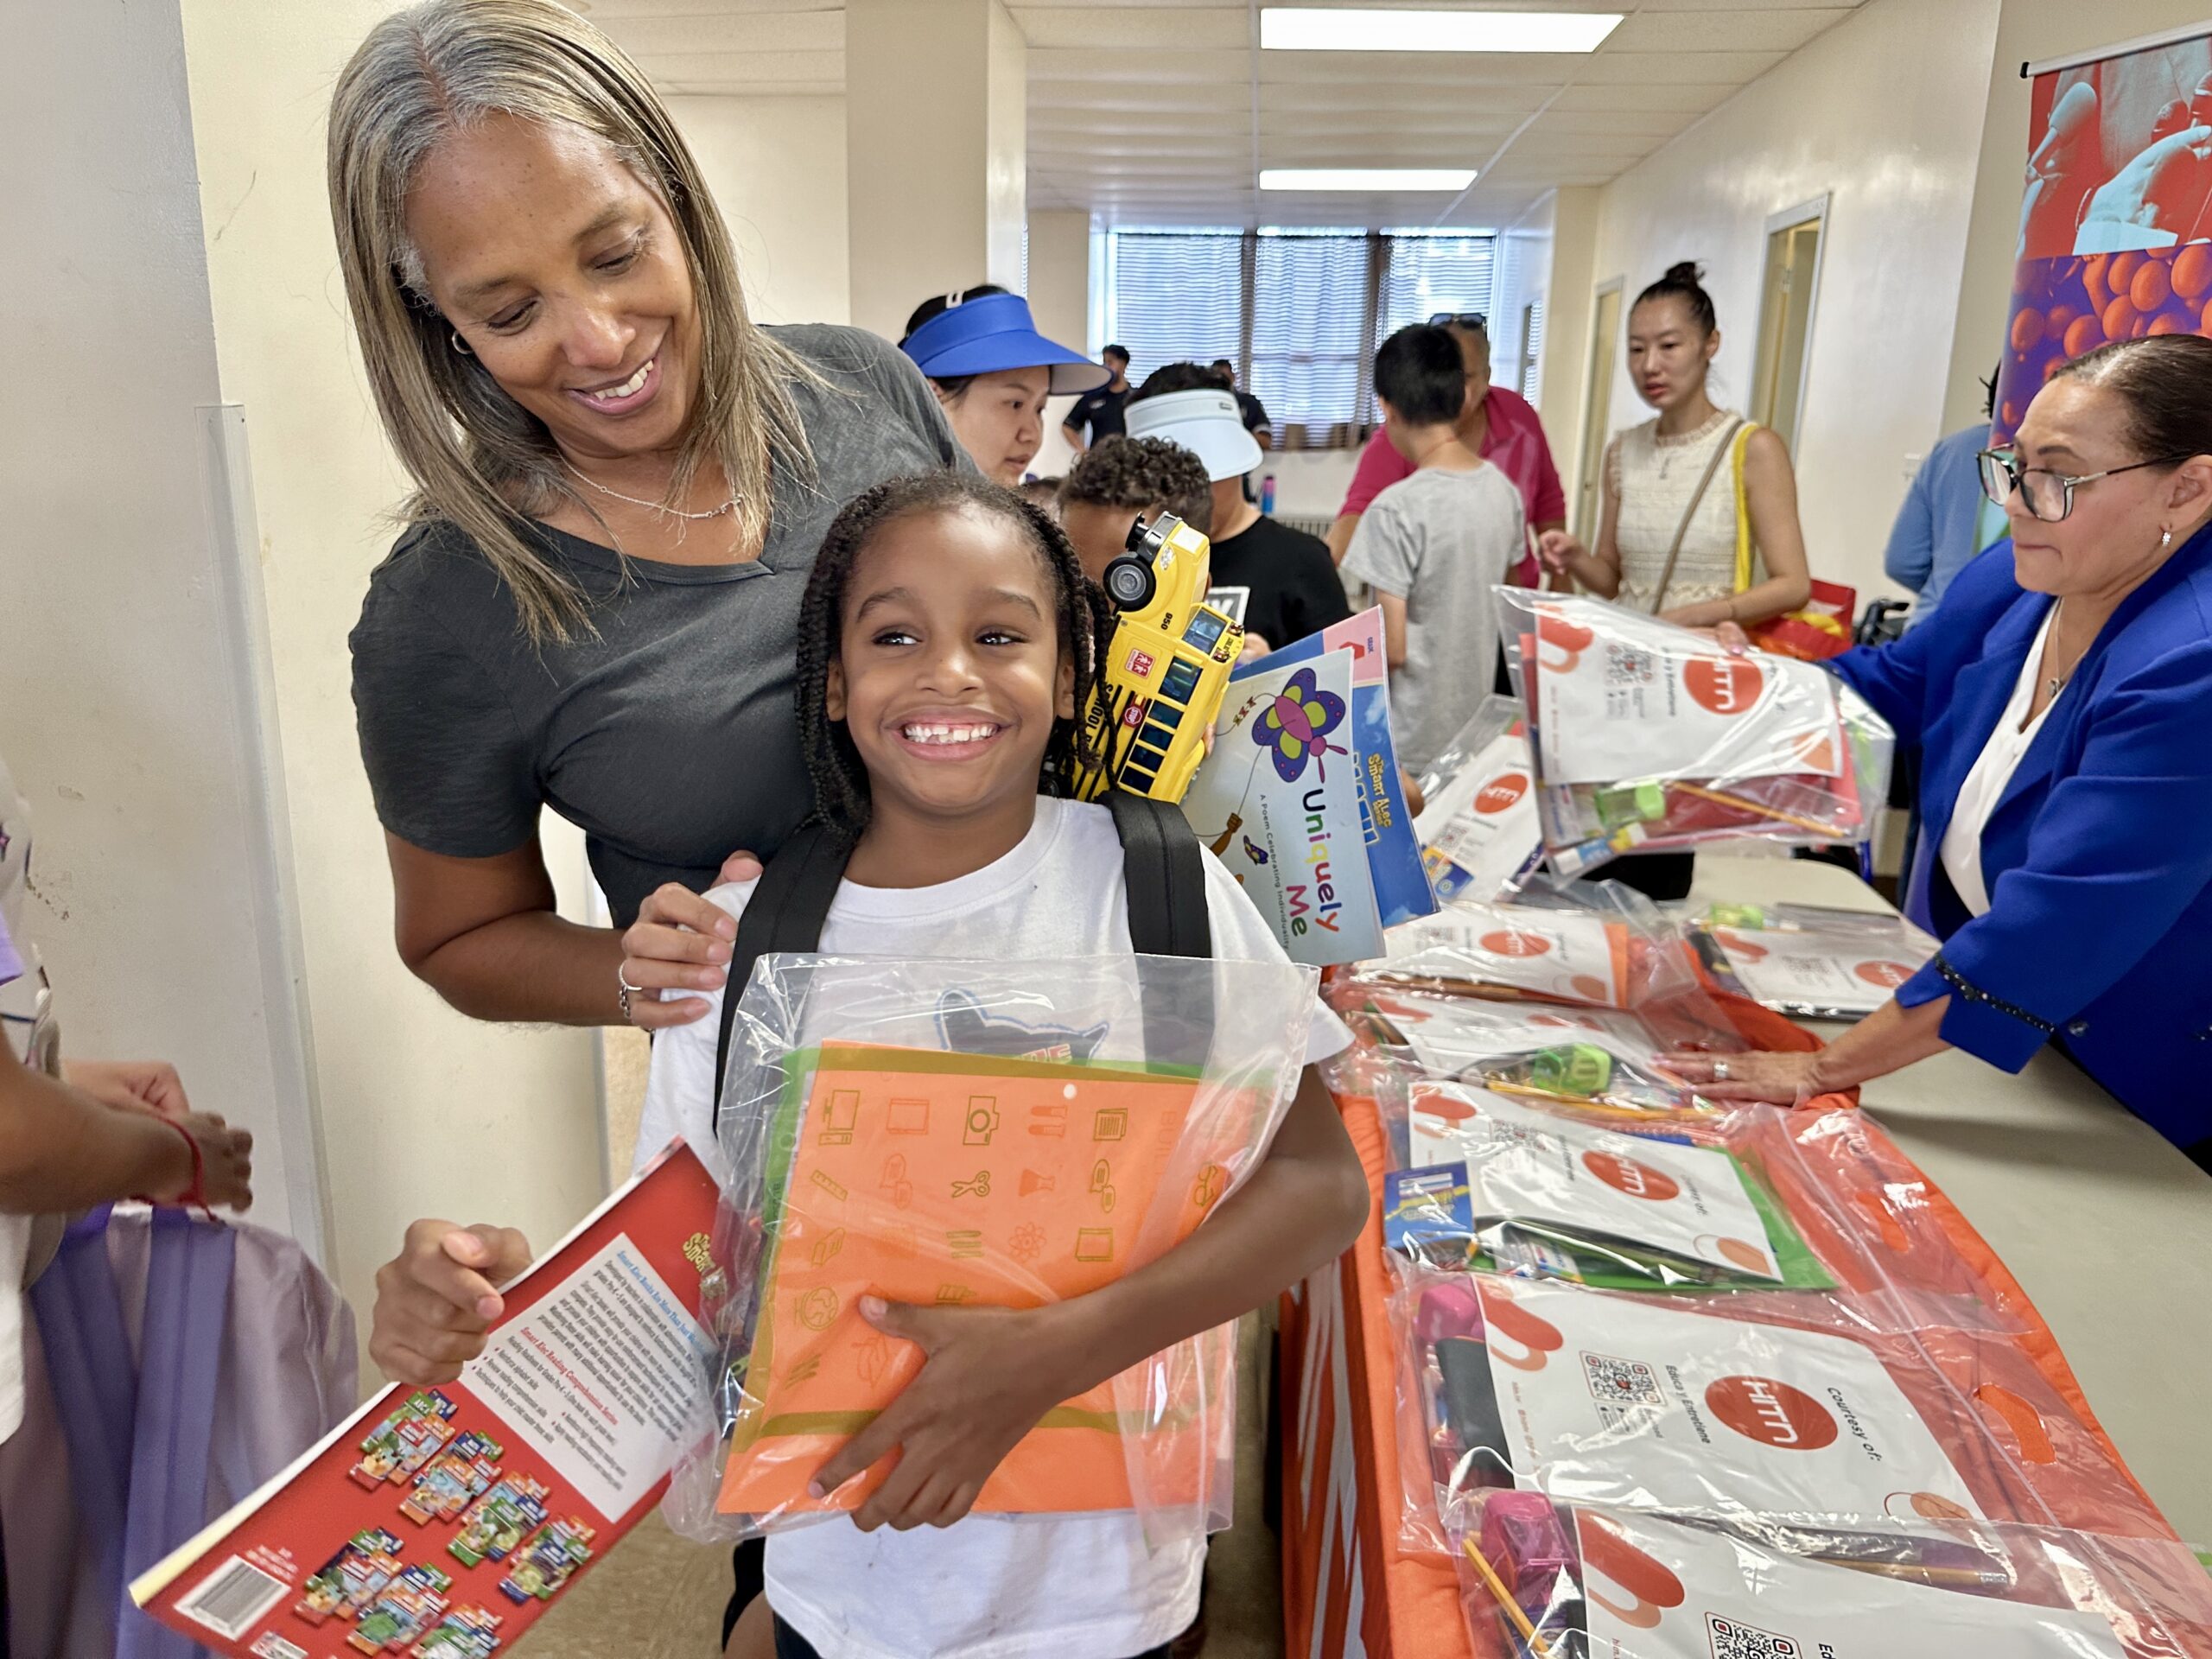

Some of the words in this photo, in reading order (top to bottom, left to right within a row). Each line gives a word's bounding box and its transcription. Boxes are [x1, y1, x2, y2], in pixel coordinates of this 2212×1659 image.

[1160, 612, 1173, 631] 950
[1126, 708, 1140, 723] STOP
[1259, 803, 1272, 830] Poem
[1264, 832, 1281, 888] Celebrating
[1300, 788, 1344, 935] Uniquely
[1275, 891, 1290, 950] Individuality
[1283, 883, 1316, 938] Me
[1664, 1363, 1687, 1391] Educa
[1681, 1398, 1712, 1445] Entretiene
[1826, 1385, 1865, 1443] Courtesy
[1861, 1440, 1882, 1463] of:
